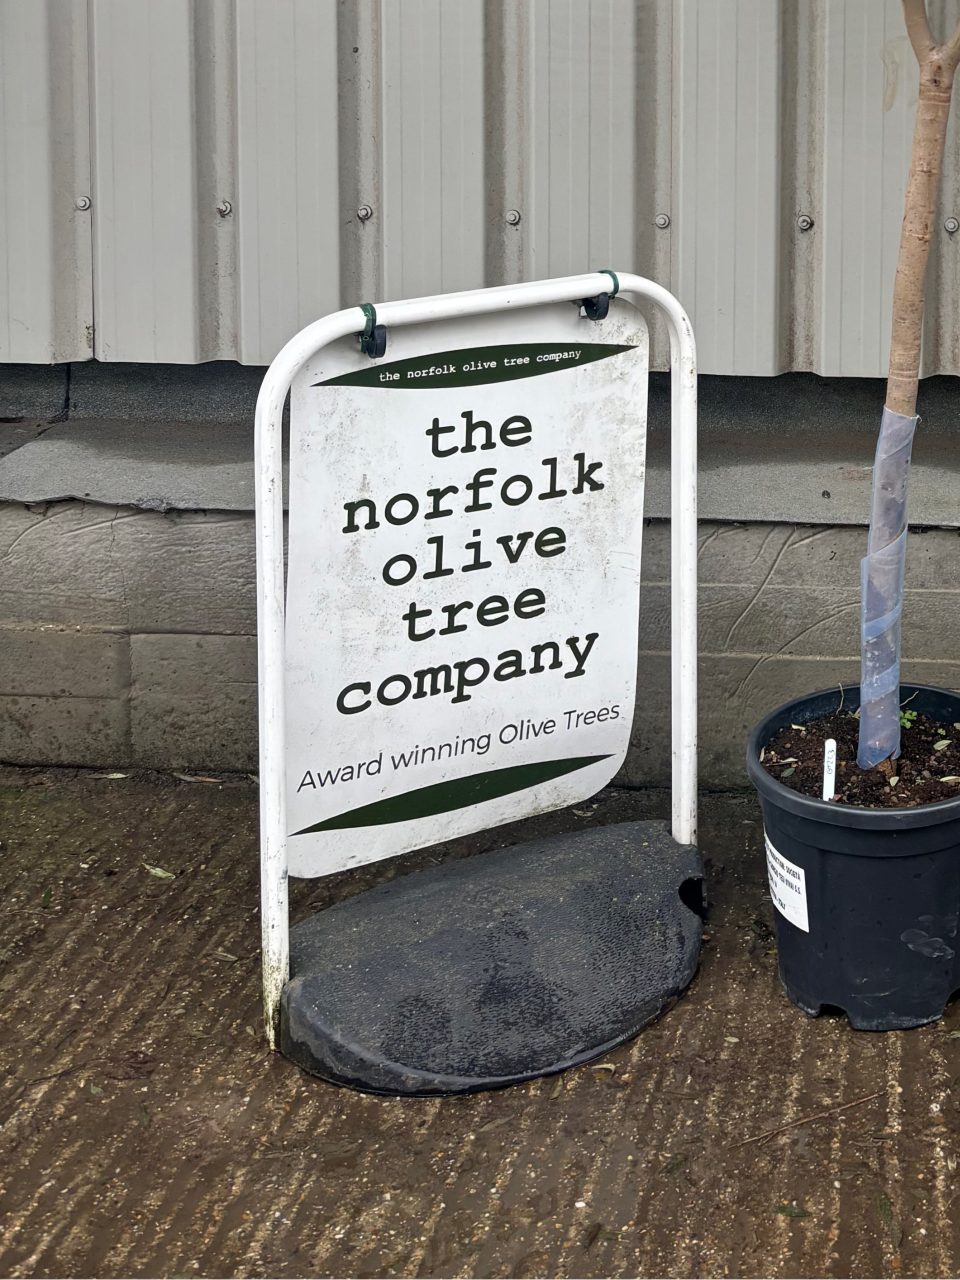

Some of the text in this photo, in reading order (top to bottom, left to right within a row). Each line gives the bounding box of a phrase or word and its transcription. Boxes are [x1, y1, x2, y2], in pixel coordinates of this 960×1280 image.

[379, 350, 582, 382] the norfolk olive tree company
[425, 410, 533, 458] the
[342, 452, 605, 534] norfolk
[382, 526, 567, 587] olive
[401, 587, 546, 642] tree
[336, 632, 600, 715] company
[296, 703, 620, 793] Award winning Olive Trees
